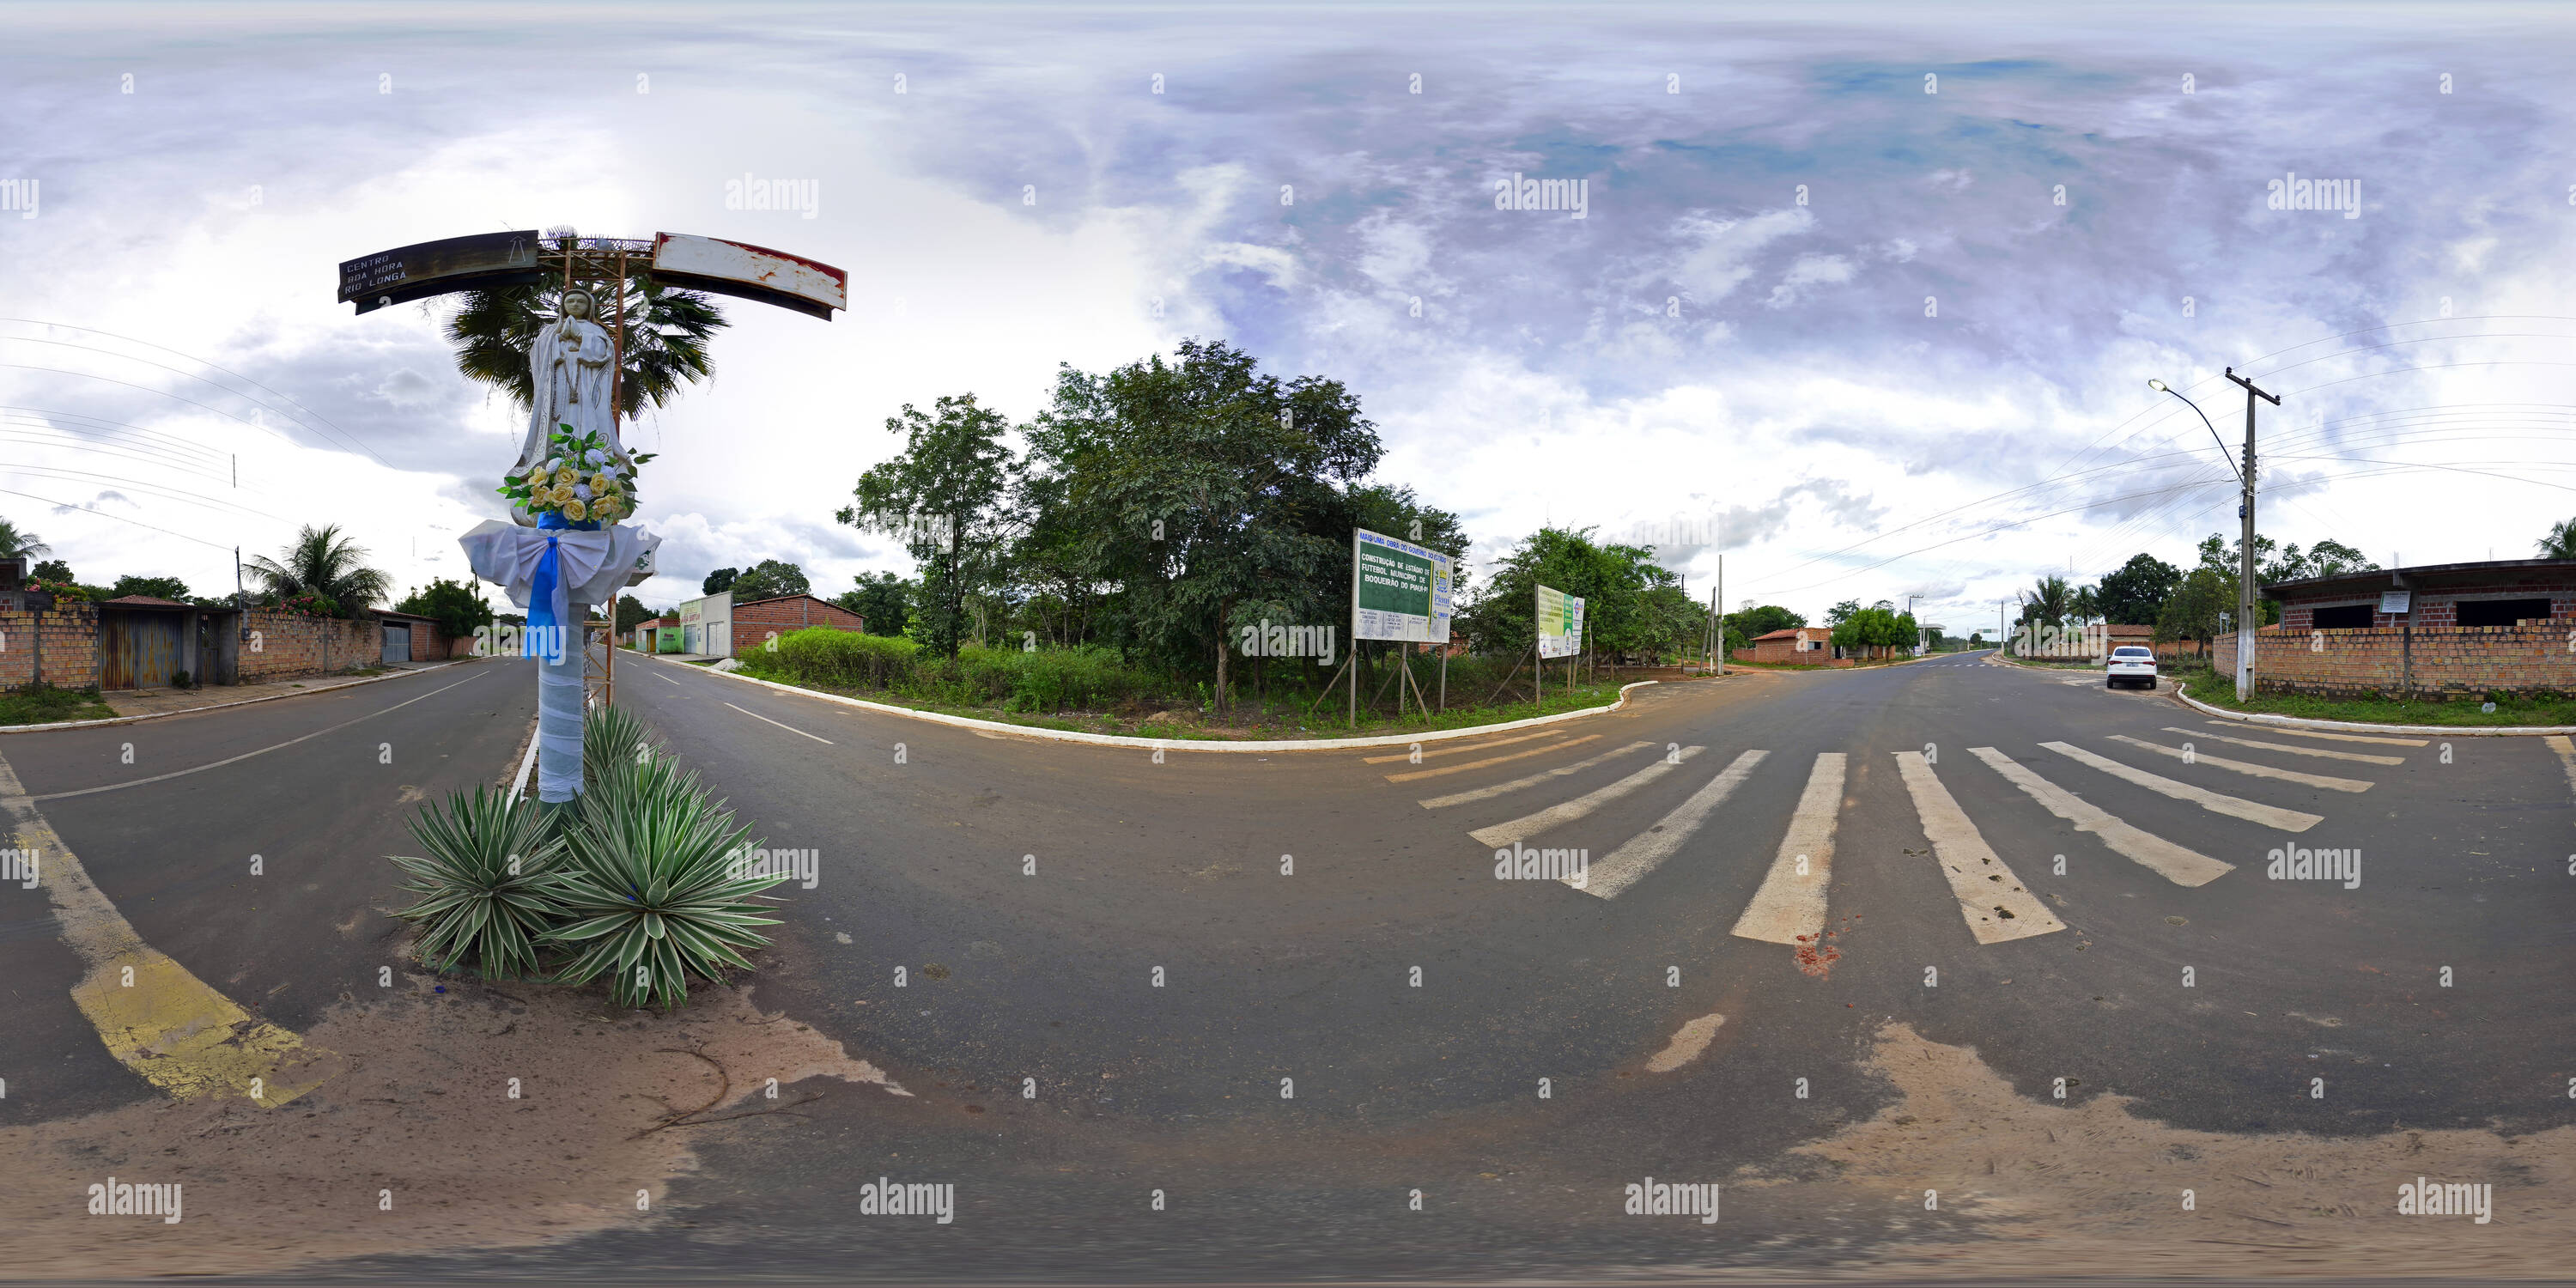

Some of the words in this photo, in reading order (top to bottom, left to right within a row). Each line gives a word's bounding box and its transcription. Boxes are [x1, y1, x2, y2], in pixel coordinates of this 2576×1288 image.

[347, 255, 389, 273] CENTRO
[348, 271, 367, 283] BOA
[375, 261, 403, 275] HORA
[345, 283, 361, 294] RIO
[1359, 532, 1372, 543] MAIS
[1373, 537, 1384, 545] UMA
[1387, 539, 1400, 550] OBRA
[1400, 543, 1407, 551] DO
[1408, 545, 1426, 557] GOVERNO
[1361, 553, 1395, 568] CONSTRUÇÃO
[1405, 563, 1423, 574] ESTÁDIO
[1361, 563, 1388, 575] FUTEBOL
[1364, 574, 1399, 587] BOQUEIRÃO
